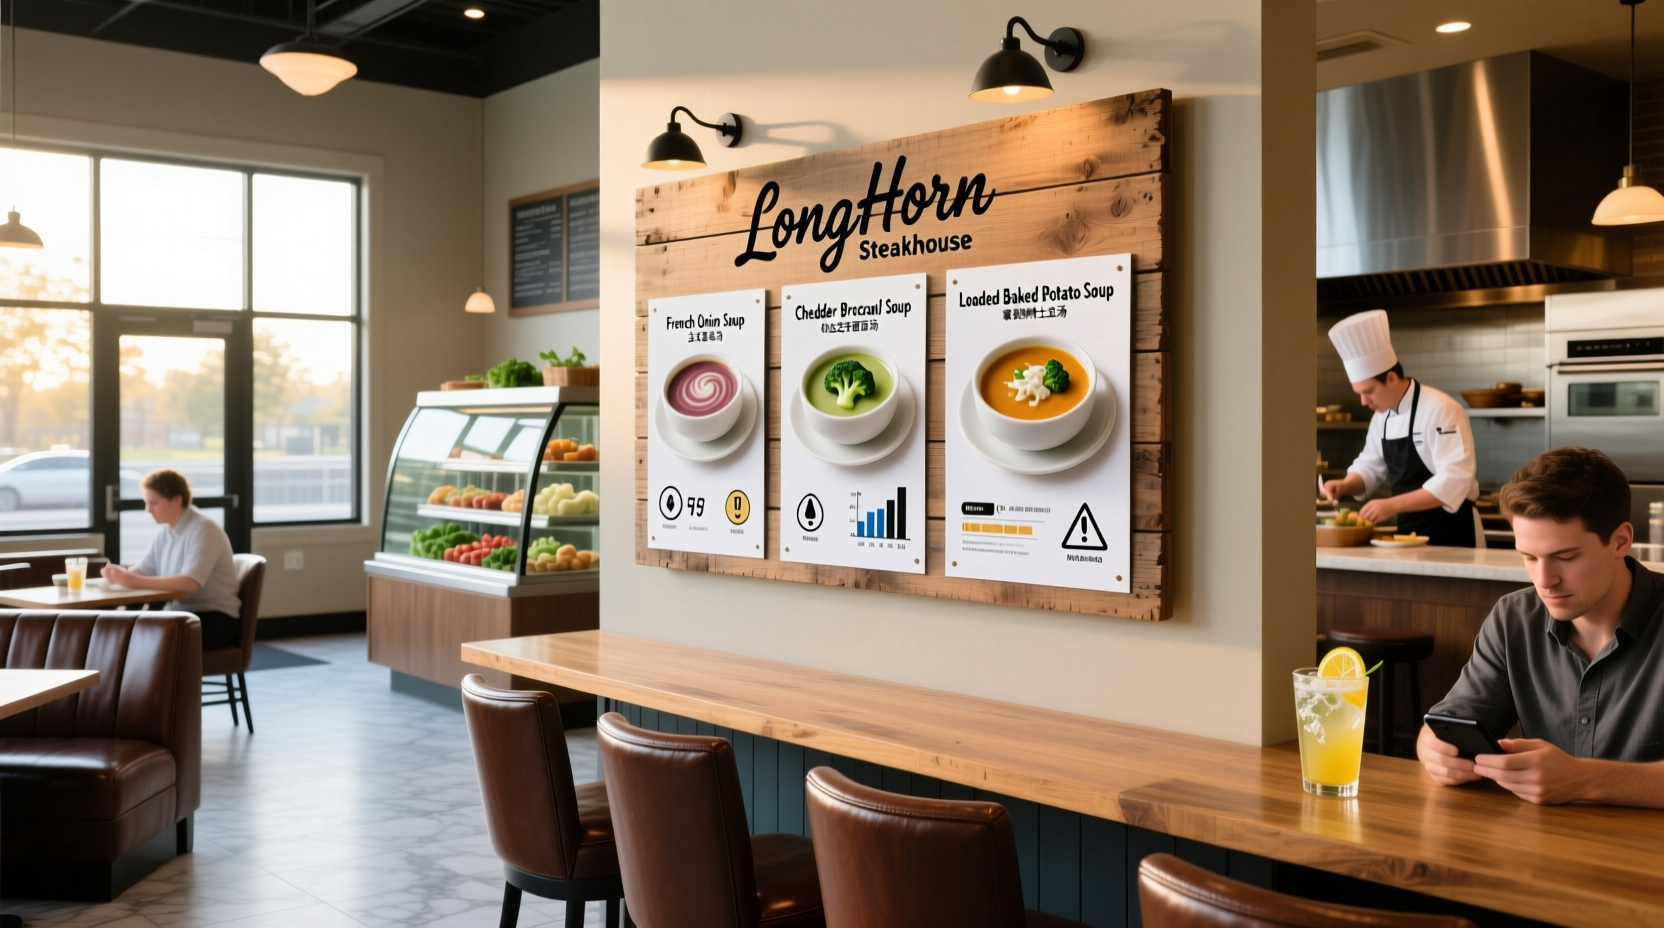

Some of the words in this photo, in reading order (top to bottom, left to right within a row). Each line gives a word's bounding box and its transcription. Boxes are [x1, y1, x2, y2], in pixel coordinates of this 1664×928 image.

[734, 155, 996, 273] LongHorn
[859, 234, 973, 260] Steakhouse
[1003, 286, 1039, 305] Baked
[1042, 285, 1081, 302] Potato
[1083, 282, 1115, 302] Soup
[885, 298, 912, 318] Soup
